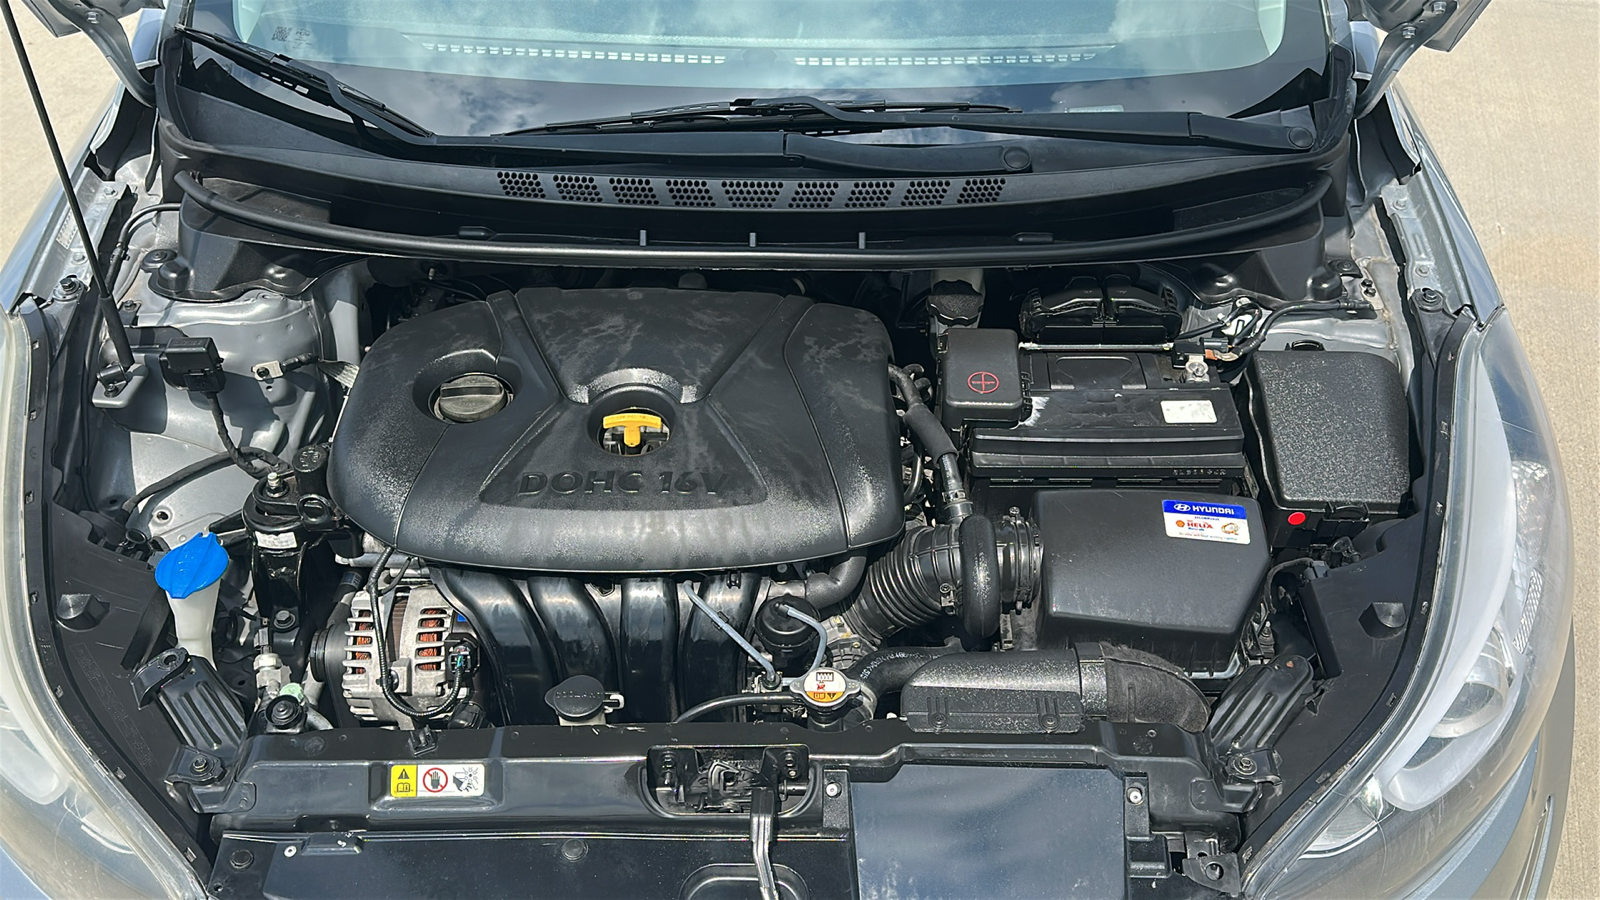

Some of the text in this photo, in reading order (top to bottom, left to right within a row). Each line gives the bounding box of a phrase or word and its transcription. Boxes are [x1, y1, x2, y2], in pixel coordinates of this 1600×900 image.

[518, 471, 730, 495] DOHC 16V
[1193, 505, 1235, 515] HYUNDAI
